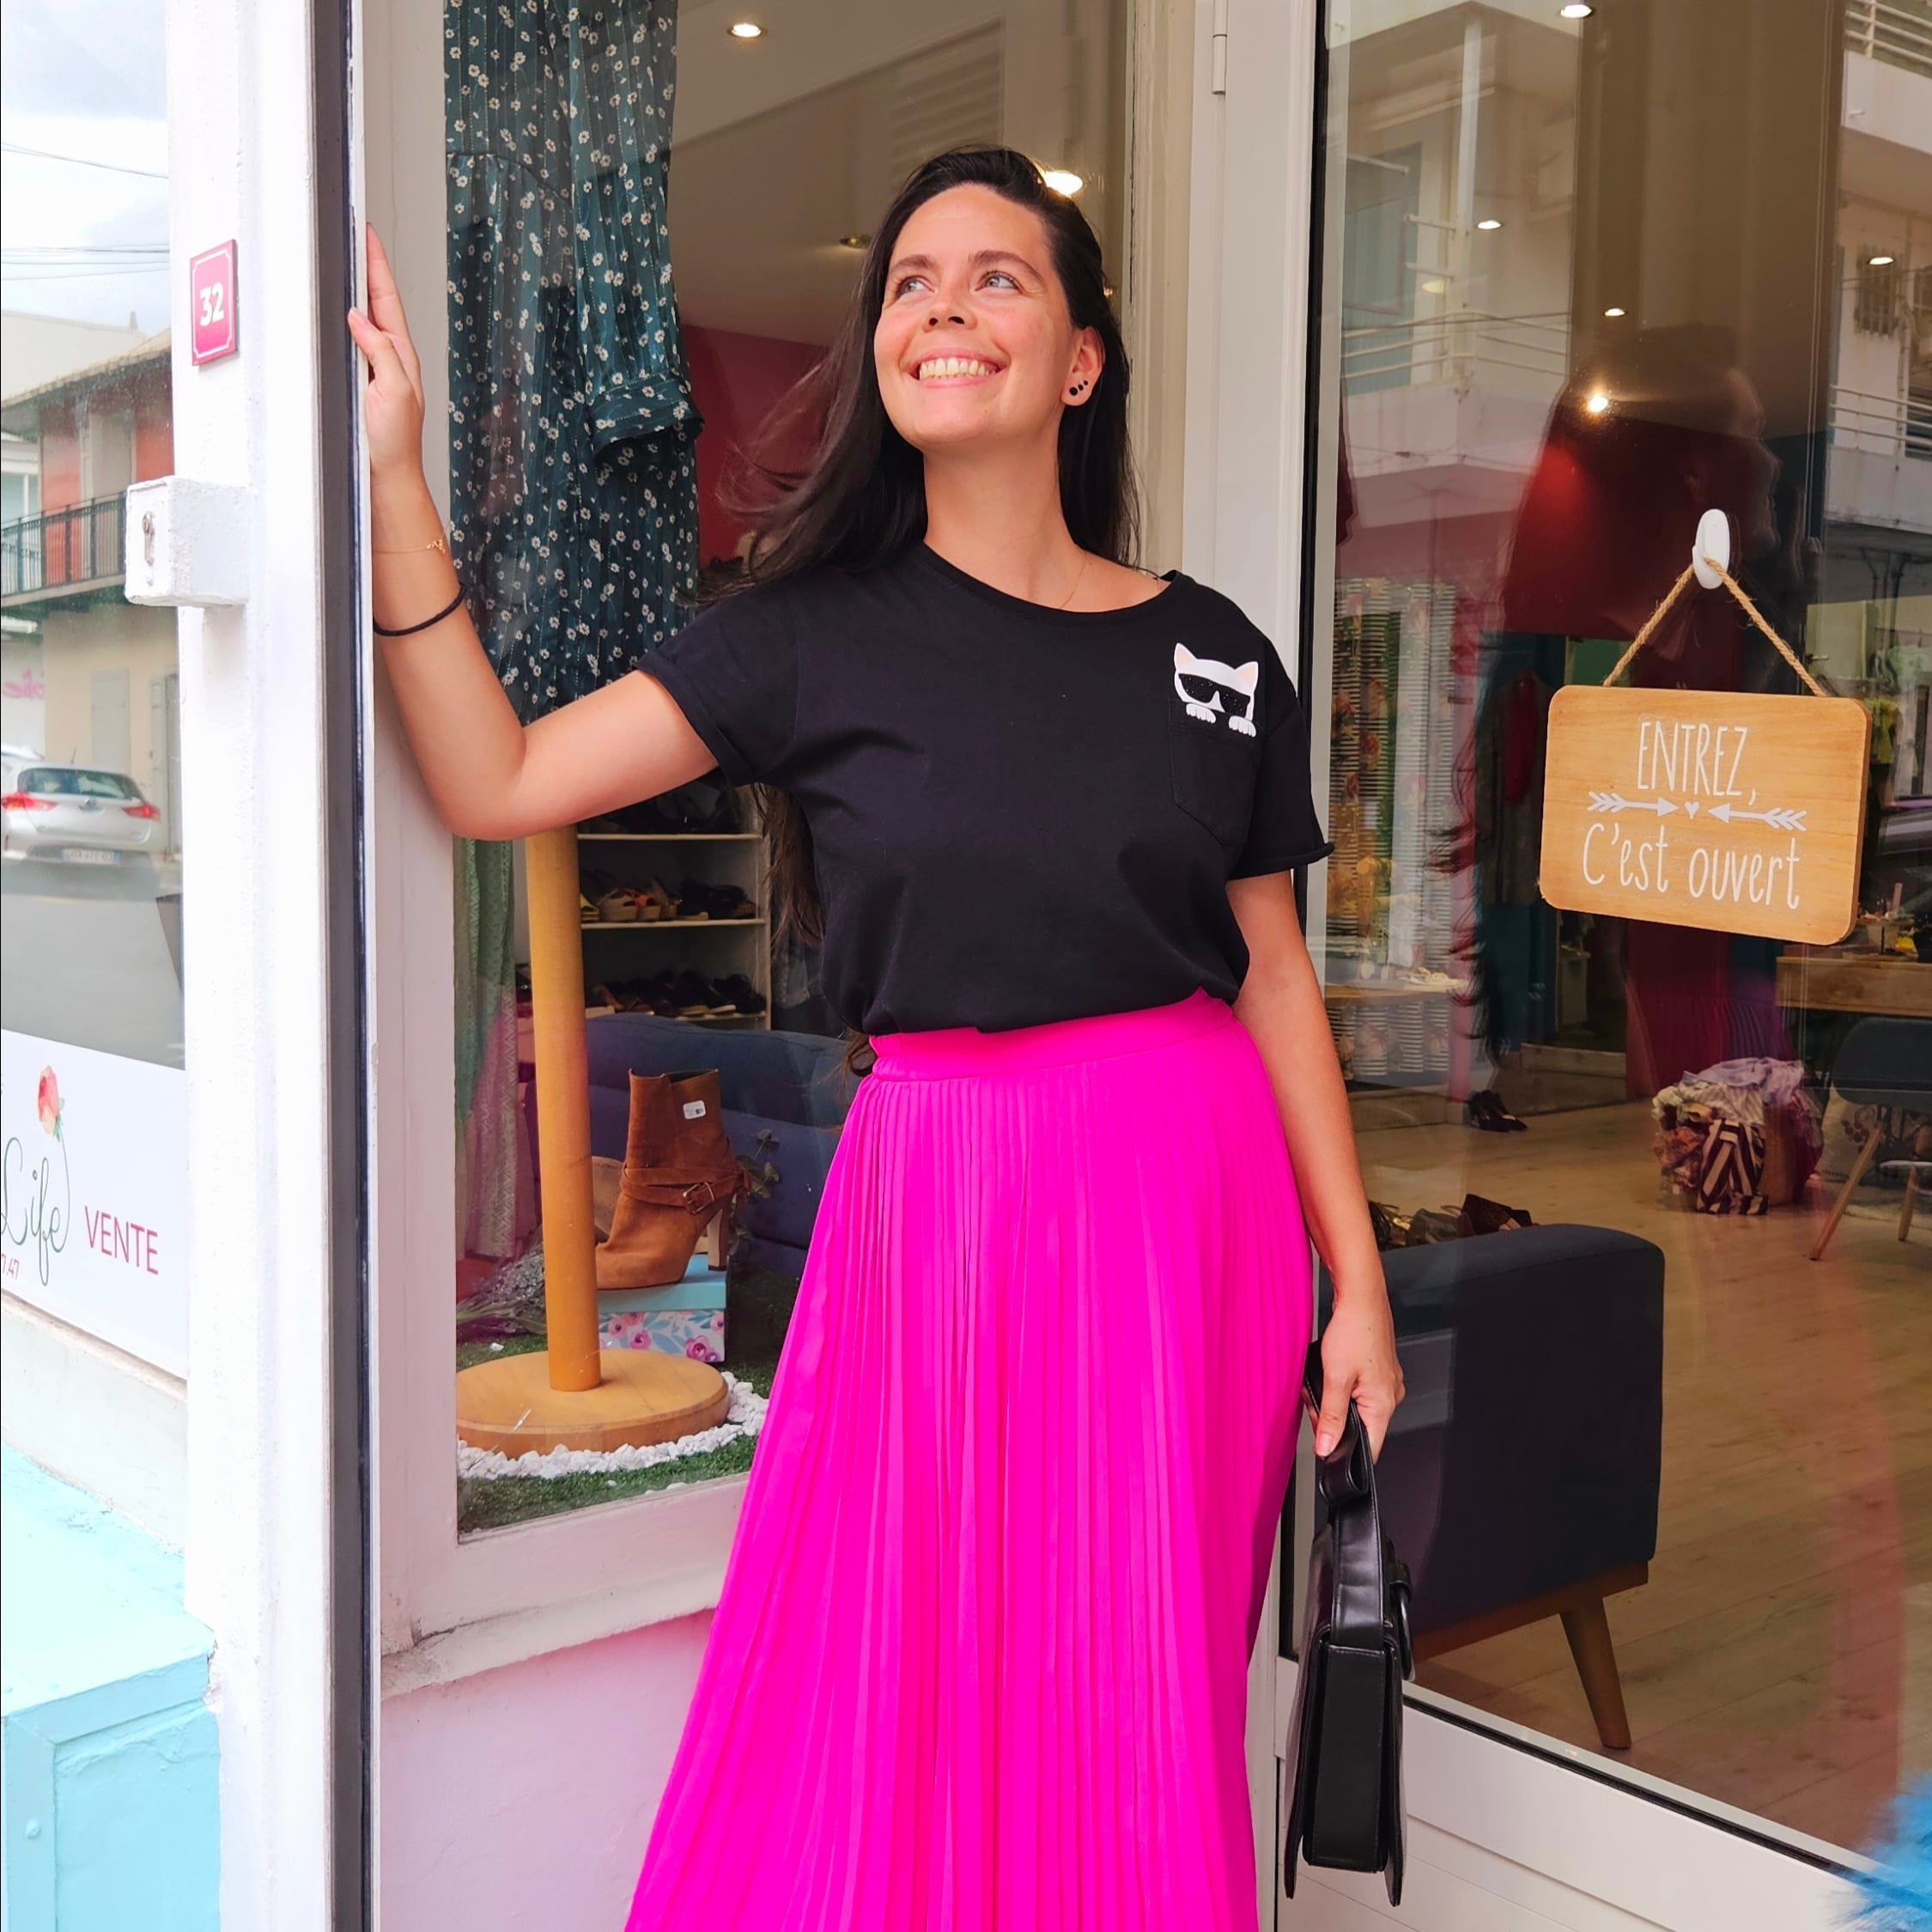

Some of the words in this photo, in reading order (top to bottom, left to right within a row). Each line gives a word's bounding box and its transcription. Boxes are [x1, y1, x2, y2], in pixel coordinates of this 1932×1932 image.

[199, 282, 225, 327] 32
[1637, 720, 1757, 805] ENTREZ,
[1582, 822, 1669, 893] C'est
[1687, 837, 1801, 910] ouvert
[1, 1137, 68, 1286] Life
[84, 1205, 159, 1275] VENTE
